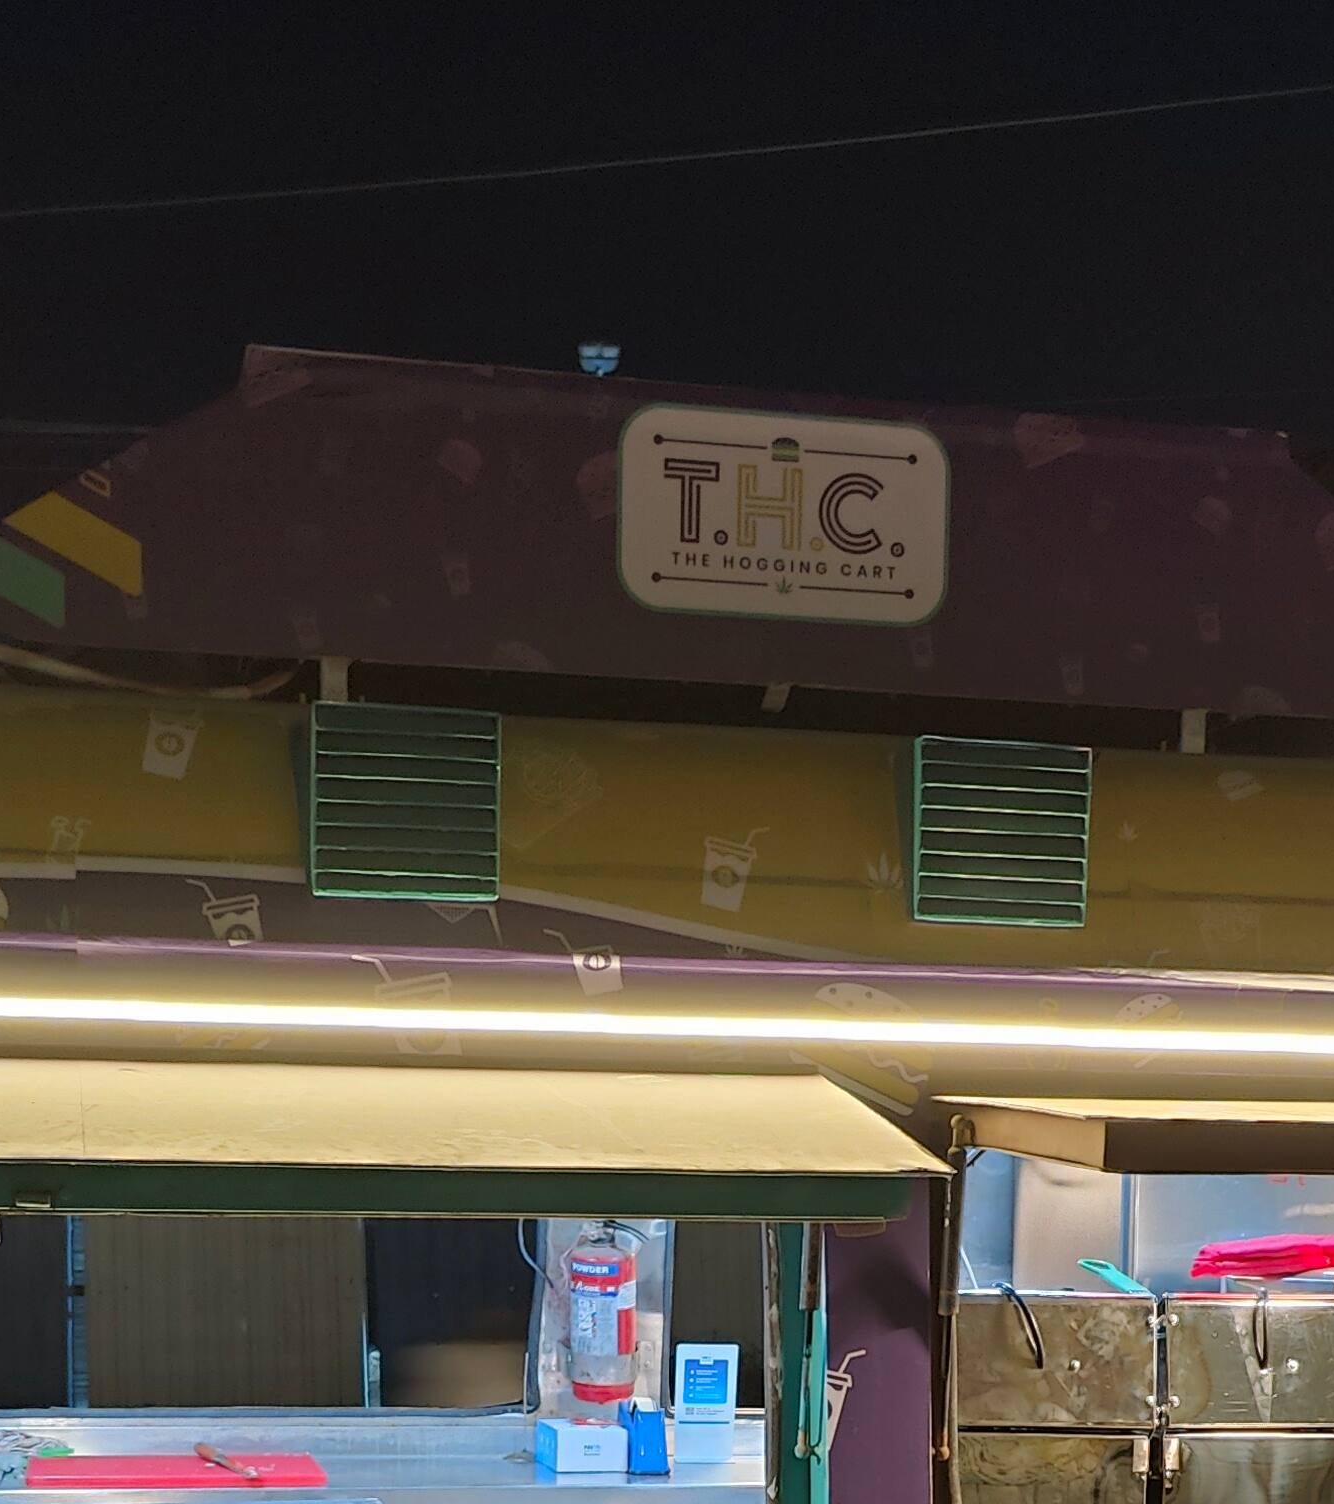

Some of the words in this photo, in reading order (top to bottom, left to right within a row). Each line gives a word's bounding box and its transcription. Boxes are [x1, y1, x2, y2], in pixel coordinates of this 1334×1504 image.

[664, 457, 905, 558] T.H.C.
[672, 551, 710, 568] THE
[723, 555, 828, 575] HOGGING
[840, 563, 898, 580] CART
